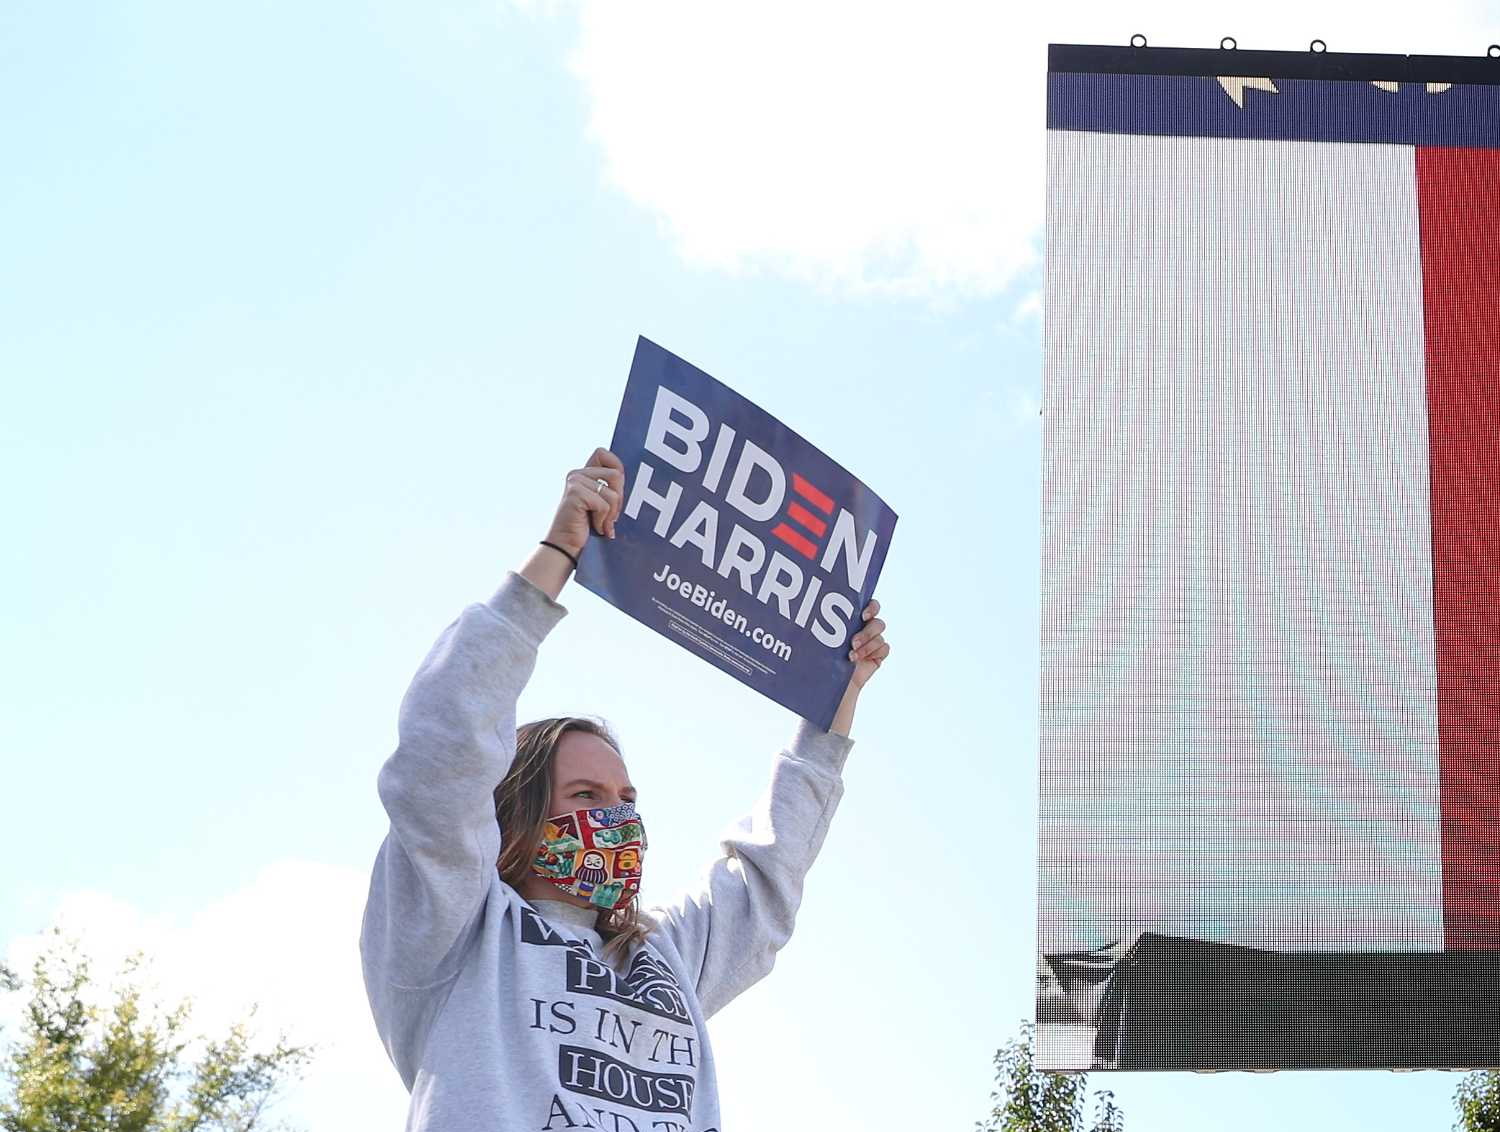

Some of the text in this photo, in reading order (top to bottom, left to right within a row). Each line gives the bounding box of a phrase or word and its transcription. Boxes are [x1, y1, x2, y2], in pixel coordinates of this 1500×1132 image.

[643, 384, 878, 594] BIDEN
[623, 461, 855, 649] HARRIS
[652, 564, 793, 662] JoeBiden.com
[530, 998, 697, 1068] IS IN TH
[574, 956, 690, 1020] PLCE
